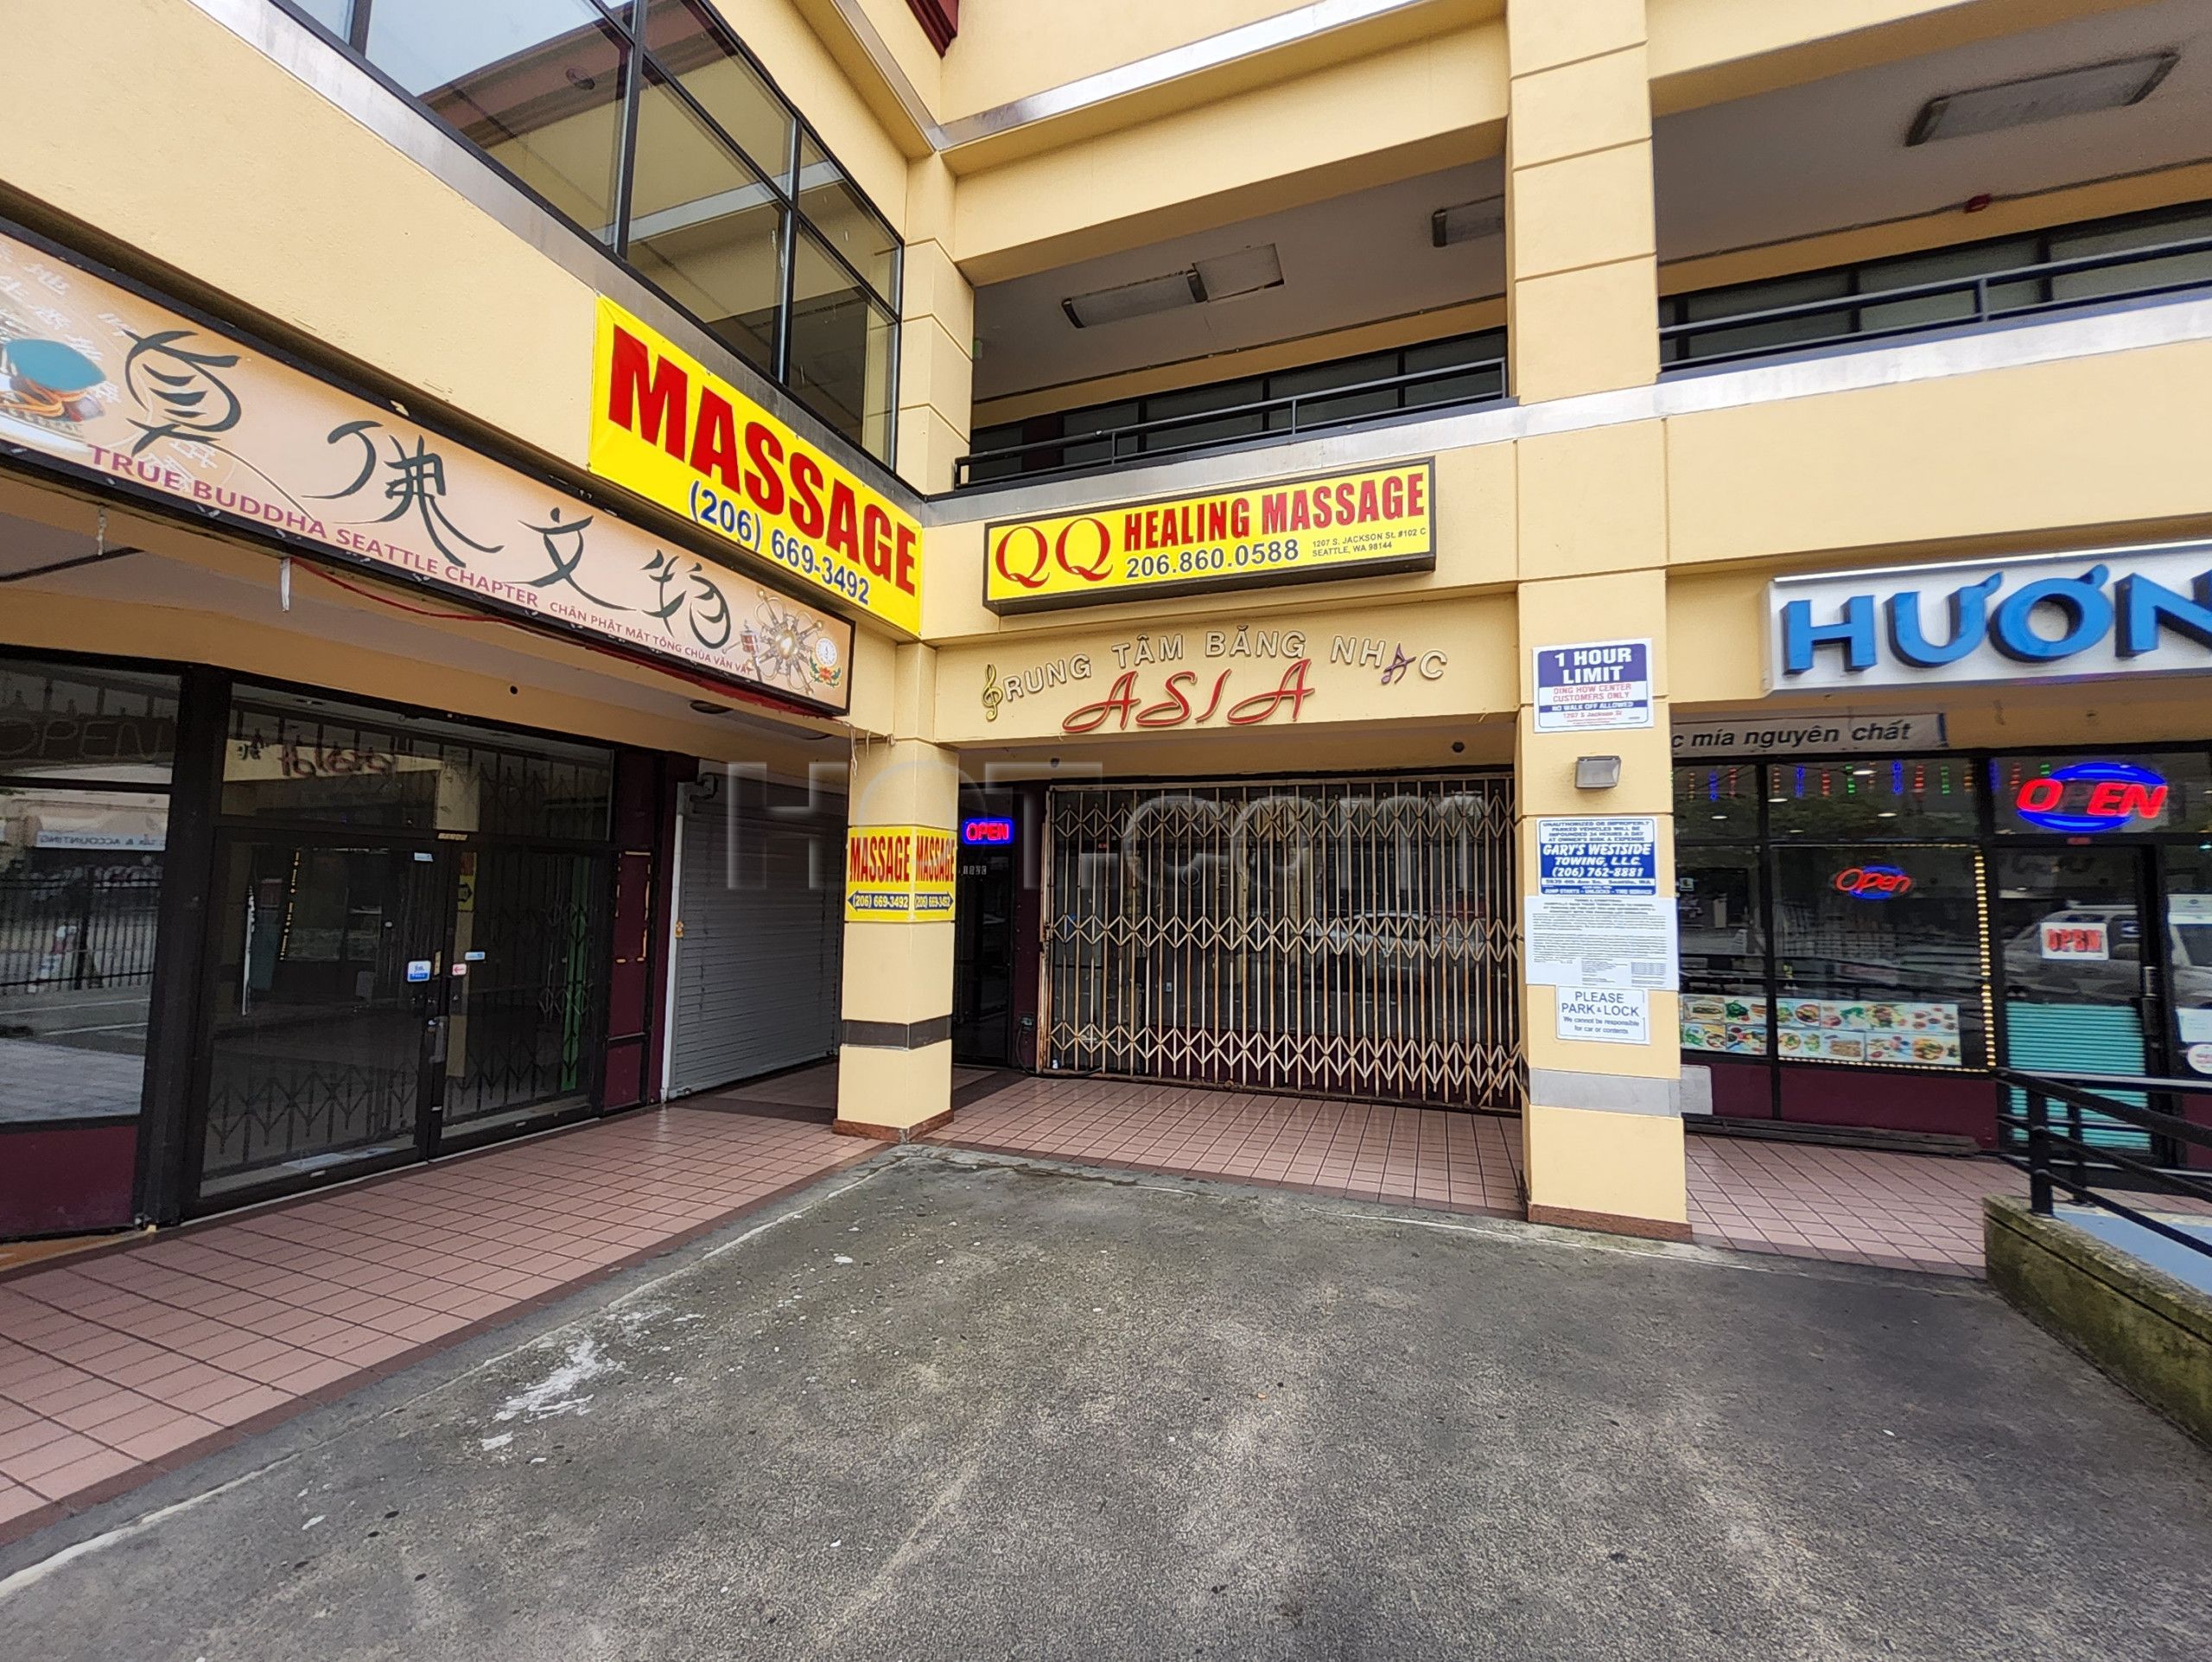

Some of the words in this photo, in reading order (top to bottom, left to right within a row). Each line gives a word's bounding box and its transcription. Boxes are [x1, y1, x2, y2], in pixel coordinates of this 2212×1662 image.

[609, 324, 916, 596] MASSAGE
[87, 443, 182, 491] TRUE
[194, 480, 327, 538] BUDDHA
[336, 528, 438, 574] SEATTLE
[445, 566, 538, 608] CHAPTER
[995, 517, 1113, 588] QQ
[1123, 497, 1250, 551] HEALING
[1262, 472, 1425, 536] MASSAGE
[690, 480, 762, 551] (206)
[771, 528, 870, 605] 669-3492
[1313, 538, 1331, 548] 1207
[1342, 532, 1383, 544] JACKSON
[1397, 528, 1417, 538] #102
[1352, 544, 1366, 553] WA
[1368, 541, 1393, 551] 98144
[1125, 538, 1300, 578] 206.860.0588
[652, 634, 683, 654] TÔNG
[1111, 634, 1185, 669] TÂM
[1205, 624, 1307, 659] BĂNG
[1554, 652, 1565, 667] 1
[1573, 647, 1632, 666] HOUR
[1562, 665, 1624, 685] LIMIT
[1062, 658, 1315, 733] ASIA
[1599, 683, 1631, 691] CENTER
[1553, 692, 1605, 703] CUSTOMERS
[1691, 728, 1734, 748] mía
[1742, 724, 1840, 749] nguyên
[966, 822, 1010, 841] OPEN
[849, 836, 911, 882] MASSAGE
[915, 835, 955, 882] MASSAGE
[1542, 844, 1586, 856] GARY'S
[1588, 844, 1652, 856] WESTSIDE
[1552, 867, 1585, 877] (206)
[1586, 867, 1644, 877] 762-8881
[1835, 868, 1912, 894] Open
[853, 894, 872, 908] (206)
[873, 894, 909, 908] 669-3492
[1574, 990, 1624, 1003] PLEASE
[1561, 1003, 1595, 1015] PARK
[1604, 1005, 1640, 1016] LOCK
